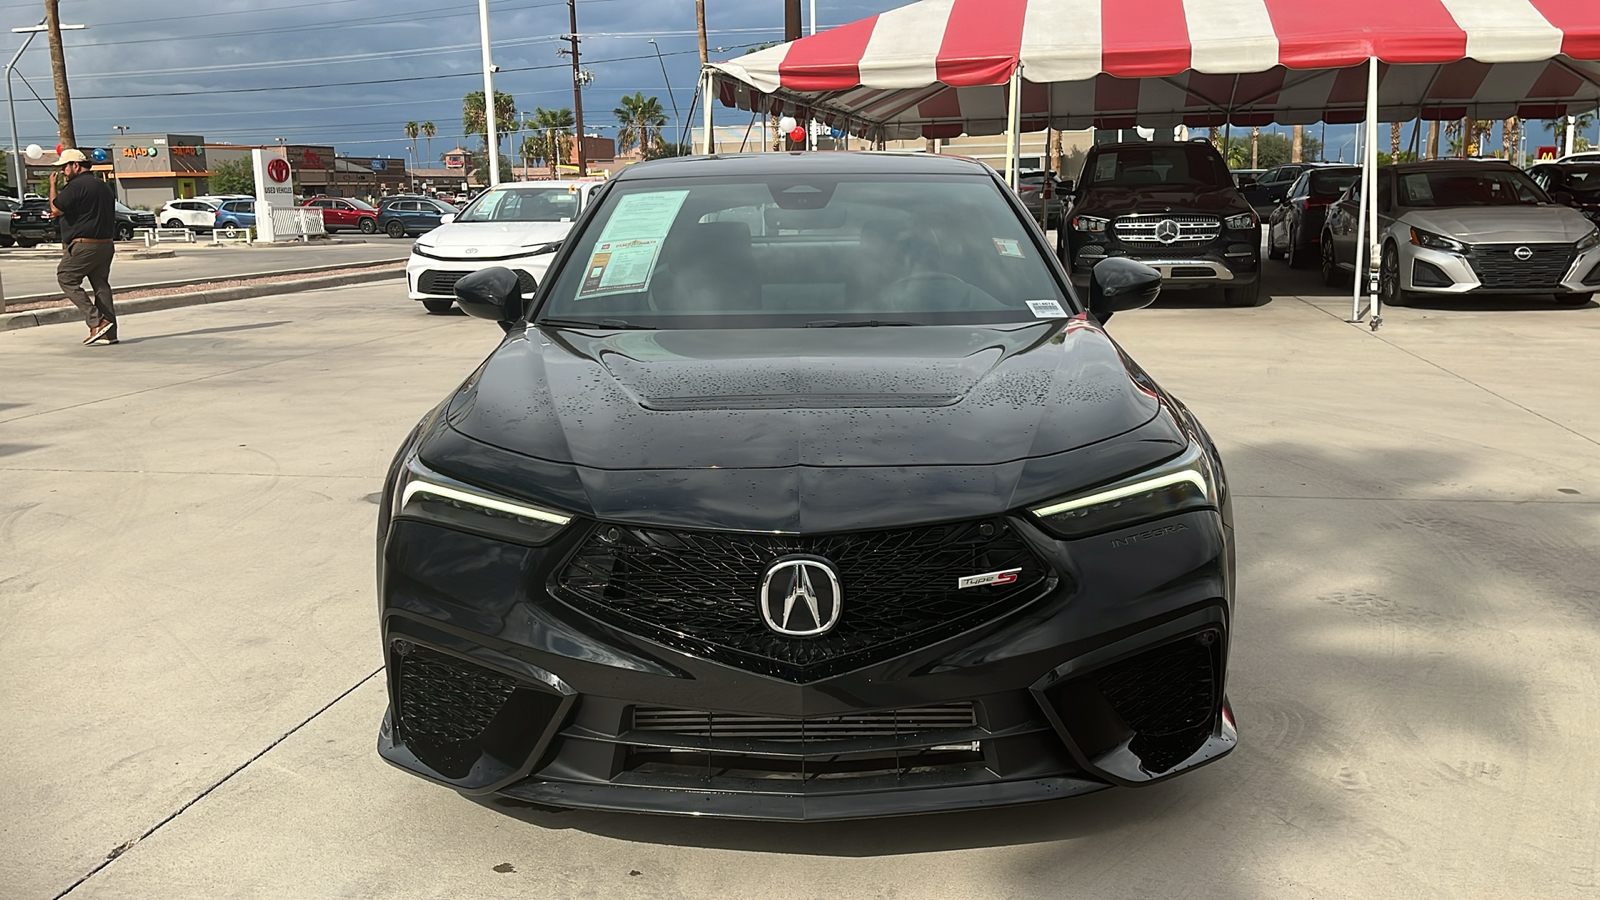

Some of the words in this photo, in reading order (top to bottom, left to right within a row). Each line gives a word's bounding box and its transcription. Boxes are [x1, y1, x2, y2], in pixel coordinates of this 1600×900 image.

[264, 186, 276, 194] USED
[276, 186, 293, 194] VEHICLES
[1110, 522, 1190, 548] INTEGRA
[963, 576, 994, 585] Type
[990, 572, 1018, 586] S
